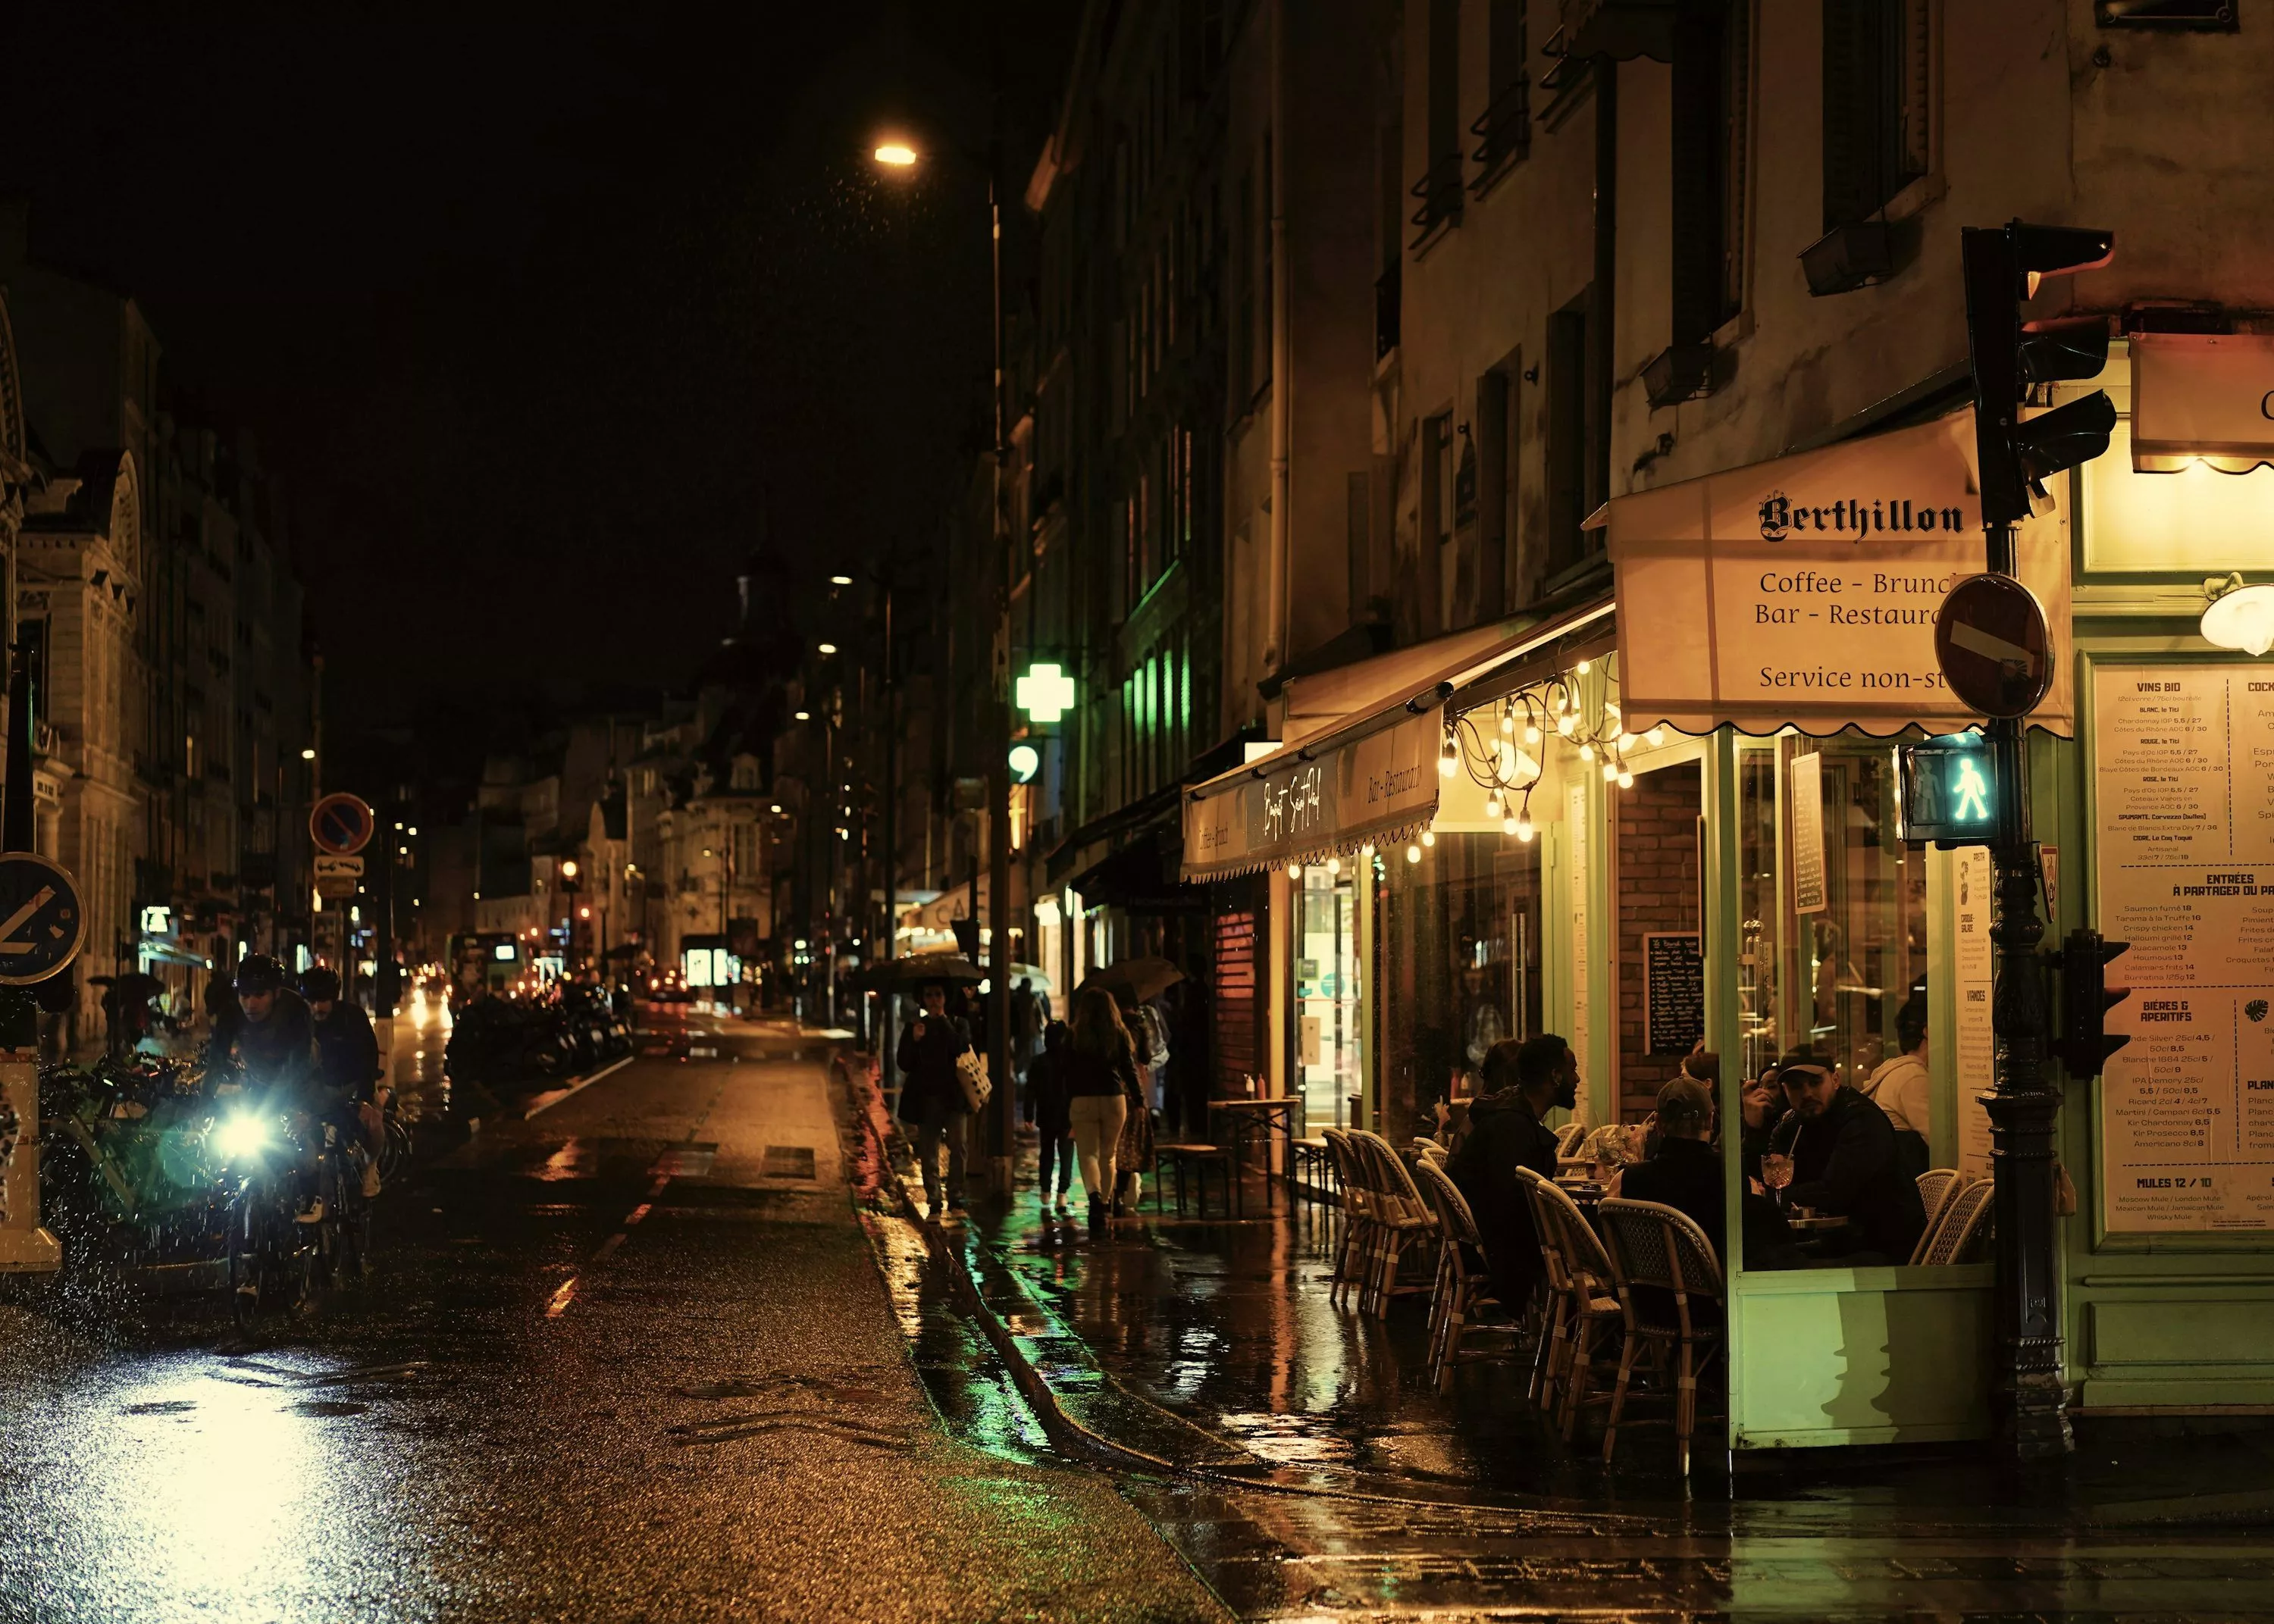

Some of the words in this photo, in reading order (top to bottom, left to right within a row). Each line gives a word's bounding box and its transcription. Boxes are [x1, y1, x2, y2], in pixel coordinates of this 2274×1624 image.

[1759, 490, 1964, 544] Berthillon
[1760, 571, 1842, 593] Coffee
[1874, 573, 1956, 593] Brunc
[1756, 605, 1799, 623] Bar
[1760, 667, 1851, 687] Service
[2137, 683, 2161, 692] VINS
[1368, 777, 1379, 803] Bar
[2207, 872, 2254, 884] ENTRÉES
[2184, 886, 2240, 896] PARTAGER
[2244, 886, 2257, 895] OU
[2141, 1012, 2191, 1022] APERITIFS
[2137, 1178, 2171, 1188] MULES
[2175, 1178, 2185, 1187] 12
